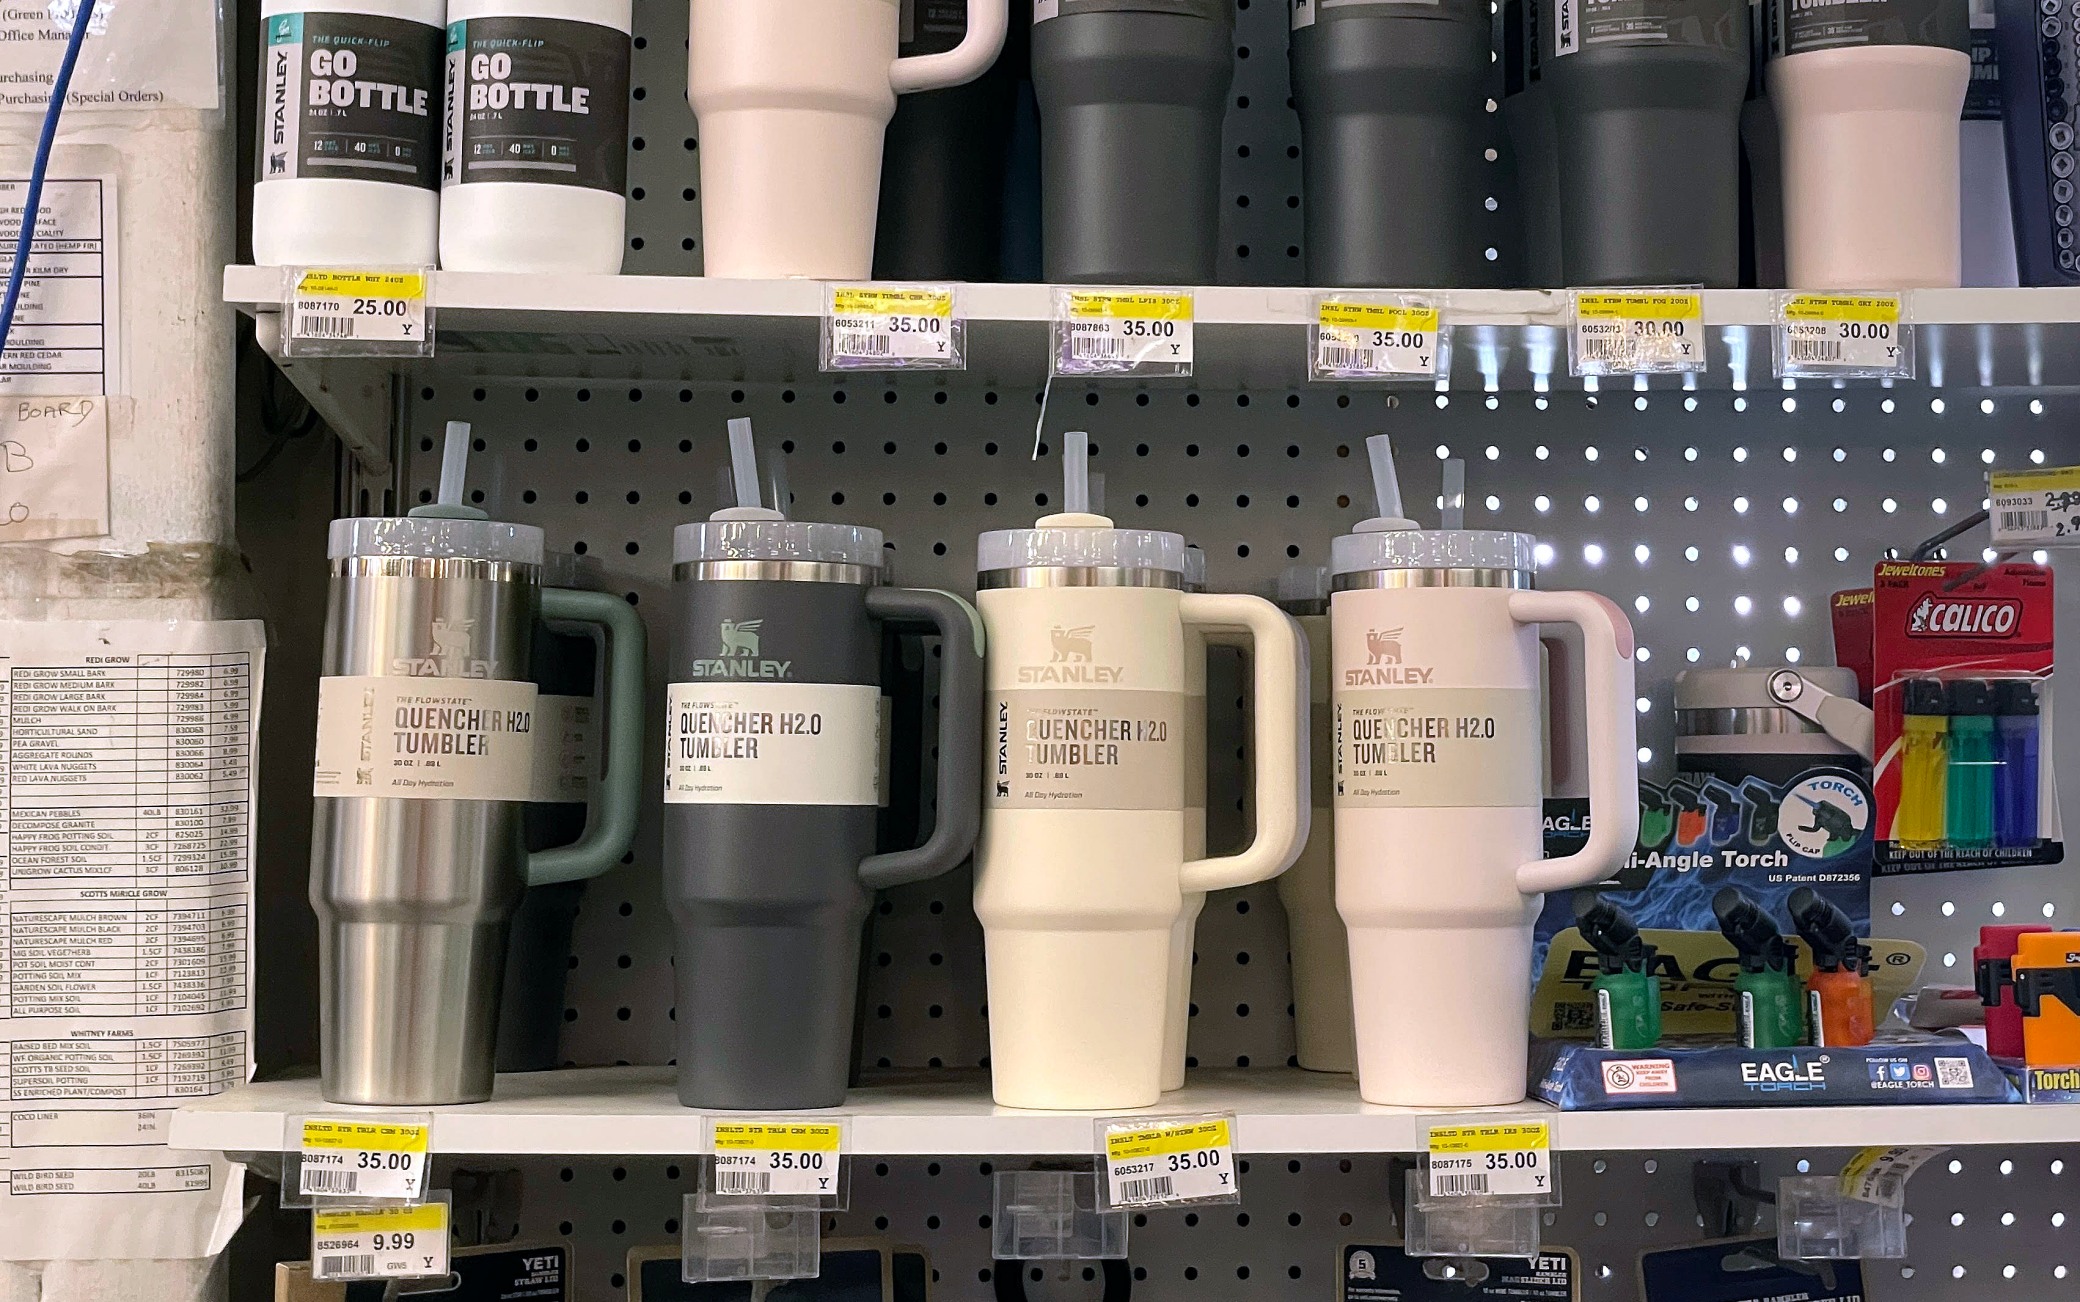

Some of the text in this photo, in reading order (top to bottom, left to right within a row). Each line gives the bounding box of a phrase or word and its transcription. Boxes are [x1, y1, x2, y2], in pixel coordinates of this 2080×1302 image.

[2, 9, 43, 21] (Green
[38, 30, 89, 41] Manar
[310, 49, 357, 77] GO
[471, 52, 512, 81] GO
[66, 90, 164, 104] (Special Orders)
[273, 52, 288, 145] STANLEY
[309, 79, 428, 116] BOTTLE
[470, 82, 590, 115] BOTTLE
[314, 140, 323, 151] 12
[354, 142, 366, 153] 40
[474, 143, 481, 154] 12
[509, 143, 521, 154] 40
[298, 301, 340, 311] 8087170
[353, 299, 407, 317] 25.00
[402, 324, 413, 335] Y
[835, 319, 875, 329] 6053211
[889, 317, 941, 333] 35.00
[1123, 320, 1174, 337] 35.00
[1839, 323, 1890, 339] 30.00
[937, 341, 946, 353] Y
[1372, 331, 1424, 348] 35.00
[1170, 344, 1181, 355] Y
[1682, 344, 1691, 355] Y
[1886, 346, 1896, 358] Y
[1420, 356, 1429, 367] Y
[18, 400, 94, 428] BOARD
[1878, 563, 1946, 577] Jeweltones
[33, 670, 58, 678] GROW
[87, 669, 106, 677] BARK
[391, 658, 499, 678] STANLEY
[692, 659, 792, 678] STANLEY
[1018, 666, 1124, 683] STANLEY
[1345, 667, 1434, 686] STANLEY
[60, 693, 84, 701] LARGE
[394, 707, 530, 734] QUENCHER H2.0
[680, 712, 822, 735] QUENCHER H2.0
[1353, 717, 1496, 740] QUENCHER H2.0
[999, 701, 1009, 775] STANLEY
[1026, 719, 1167, 742] QUENCHER H2.0
[393, 732, 490, 756] TUMBLER
[680, 737, 759, 759] TUMBLER
[1026, 743, 1119, 765] TUMBLER
[1353, 742, 1436, 764] TUMBLER
[1806, 781, 1863, 806] TORCH
[1786, 833, 1820, 855] FLIP CAP
[1721, 850, 1788, 868] Torch
[1785, 875, 1816, 883] Patent
[1819, 874, 1860, 882] D872356
[1741, 1055, 1825, 1082] EAGLE
[1870, 1080, 1935, 1089] @EAGLE_TORCH
[357, 1152, 412, 1171] 35.00
[770, 1152, 823, 1170] 35.00
[1114, 1162, 1155, 1176] 6053217
[1168, 1149, 1220, 1172] 35.00
[1431, 1159, 1472, 1169] 8087175
[1485, 1151, 1537, 1170] 35.00
[818, 1177, 830, 1189] Y
[1219, 1172, 1229, 1185] Y
[1534, 1175, 1545, 1187] Y
[317, 1240, 359, 1250] 8526964
[373, 1232, 415, 1251] 9.99
[423, 1256, 434, 1268] Y
[522, 1254, 559, 1271] YETI
[1359, 1259, 1366, 1269] 5
[1527, 1256, 1566, 1271] YETI
